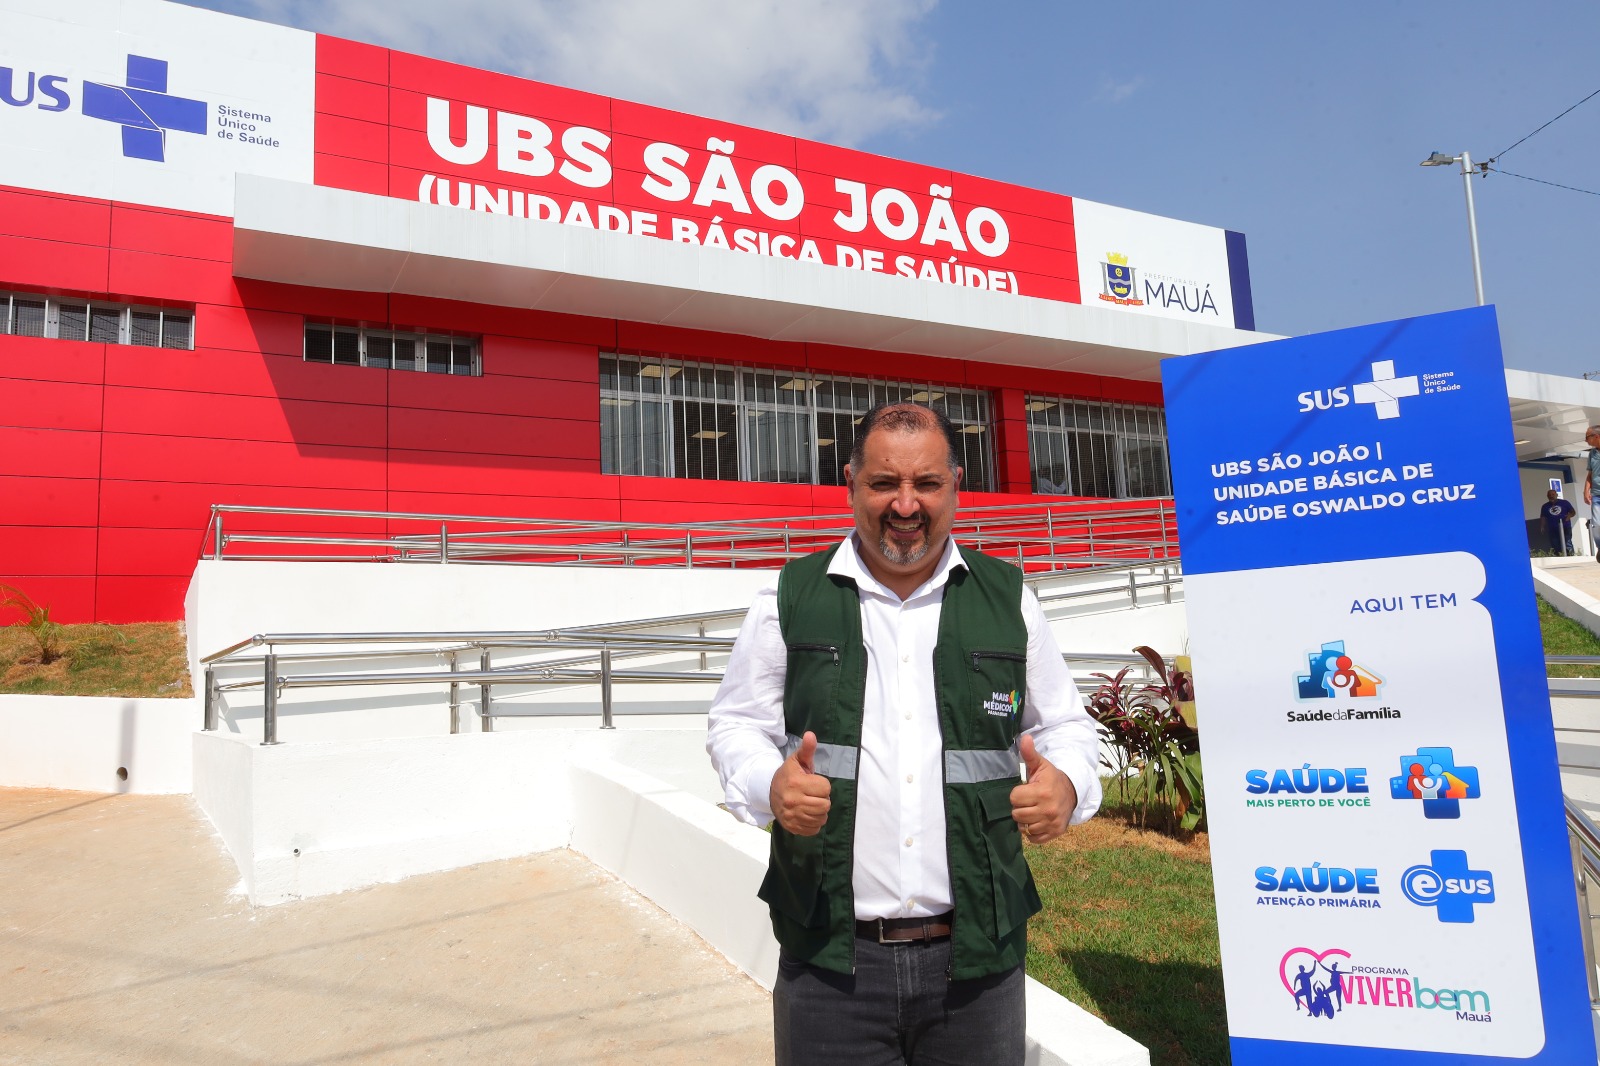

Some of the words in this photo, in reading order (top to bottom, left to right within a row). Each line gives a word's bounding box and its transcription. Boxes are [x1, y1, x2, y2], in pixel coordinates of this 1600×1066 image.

[217, 104, 272, 123] Sistema
[217, 116, 257, 132] Único
[217, 128, 234, 140] de
[238, 132, 280, 148] Saúde
[426, 96, 613, 188] UBS
[641, 136, 805, 221] SÃO
[833, 183, 1010, 258] JOÃO
[418, 173, 658, 239] (UNIDADE
[671, 215, 825, 265] BÁSICA
[836, 244, 884, 274] DE
[1144, 272, 1187, 284] PREFEITURA
[1144, 279, 1219, 315] MAUÁ
[1422, 371, 1454, 380] Sistema
[1423, 378, 1446, 387] Único
[1436, 384, 1461, 392] Saúde
[1297, 386, 1350, 412] SUS
[1211, 459, 1252, 478] UBS
[1257, 452, 1302, 473] SÃO
[1308, 443, 1369, 467] JOÃO
[1213, 477, 1308, 502] UNIDADE
[1313, 467, 1397, 491] BÁSICA
[1402, 462, 1434, 482] DE
[1216, 504, 1287, 525] SAÚDE
[1292, 491, 1406, 518] OSWALDO
[1411, 484, 1476, 505] CRUZ
[1350, 596, 1403, 614] AQUI
[1411, 592, 1457, 610] TEM
[983, 700, 1012, 712] MÉDICOS
[992, 691, 1009, 702] MAIS
[1245, 763, 1370, 795] SAÚDE
[1246, 798, 1275, 808] MAIS
[1277, 798, 1316, 808] PERTO
[1318, 798, 1335, 807] DE
[1337, 796, 1371, 807] VOCÊ
[1254, 861, 1380, 895] SAÚDE
[1256, 895, 1316, 908] ATENÇÃO
[1318, 897, 1382, 909] PRIMÁRIA
[1351, 965, 1409, 976] PROGRAMA
[1456, 1011, 1492, 1023] Mauá
